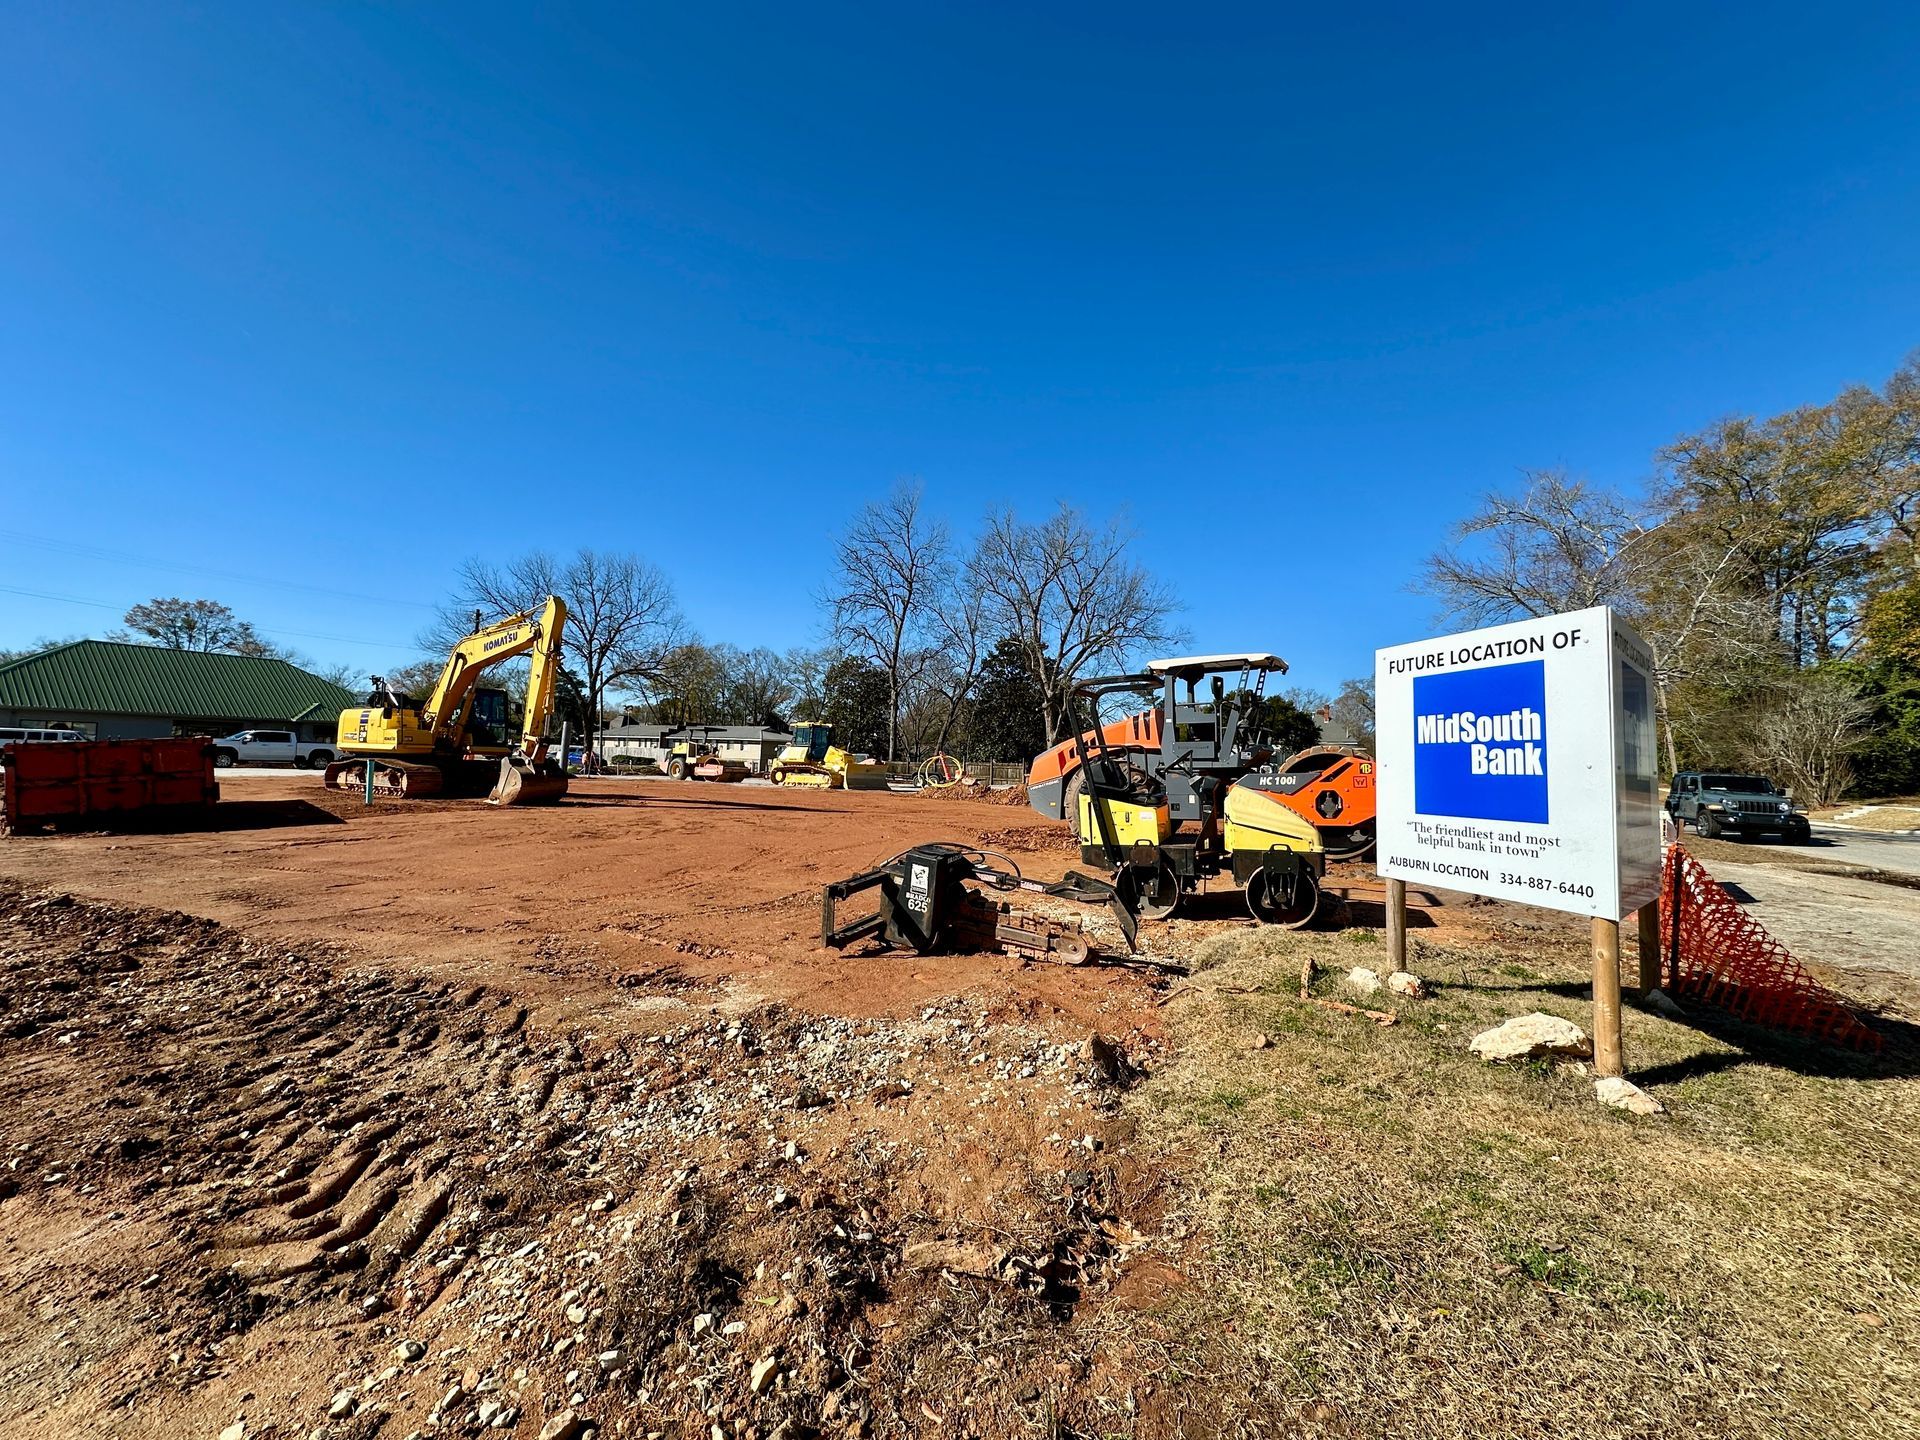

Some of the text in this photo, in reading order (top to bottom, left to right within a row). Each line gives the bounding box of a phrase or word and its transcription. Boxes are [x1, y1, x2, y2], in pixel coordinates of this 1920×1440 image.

[483, 631, 518, 652] KOMATSU
[1389, 629, 1581, 674] FUTURE LOCATION OF
[1417, 707, 1541, 744] MidSouth
[1470, 742, 1543, 775] Bank
[1259, 775, 1297, 785] HC 100i
[1406, 821, 1561, 848] “The friendliest and most
[1417, 834, 1546, 858] helpful bank in town”
[1389, 856, 1594, 898] AUBURN LOCATION 334-887-6440
[907, 899, 928, 913] 625
